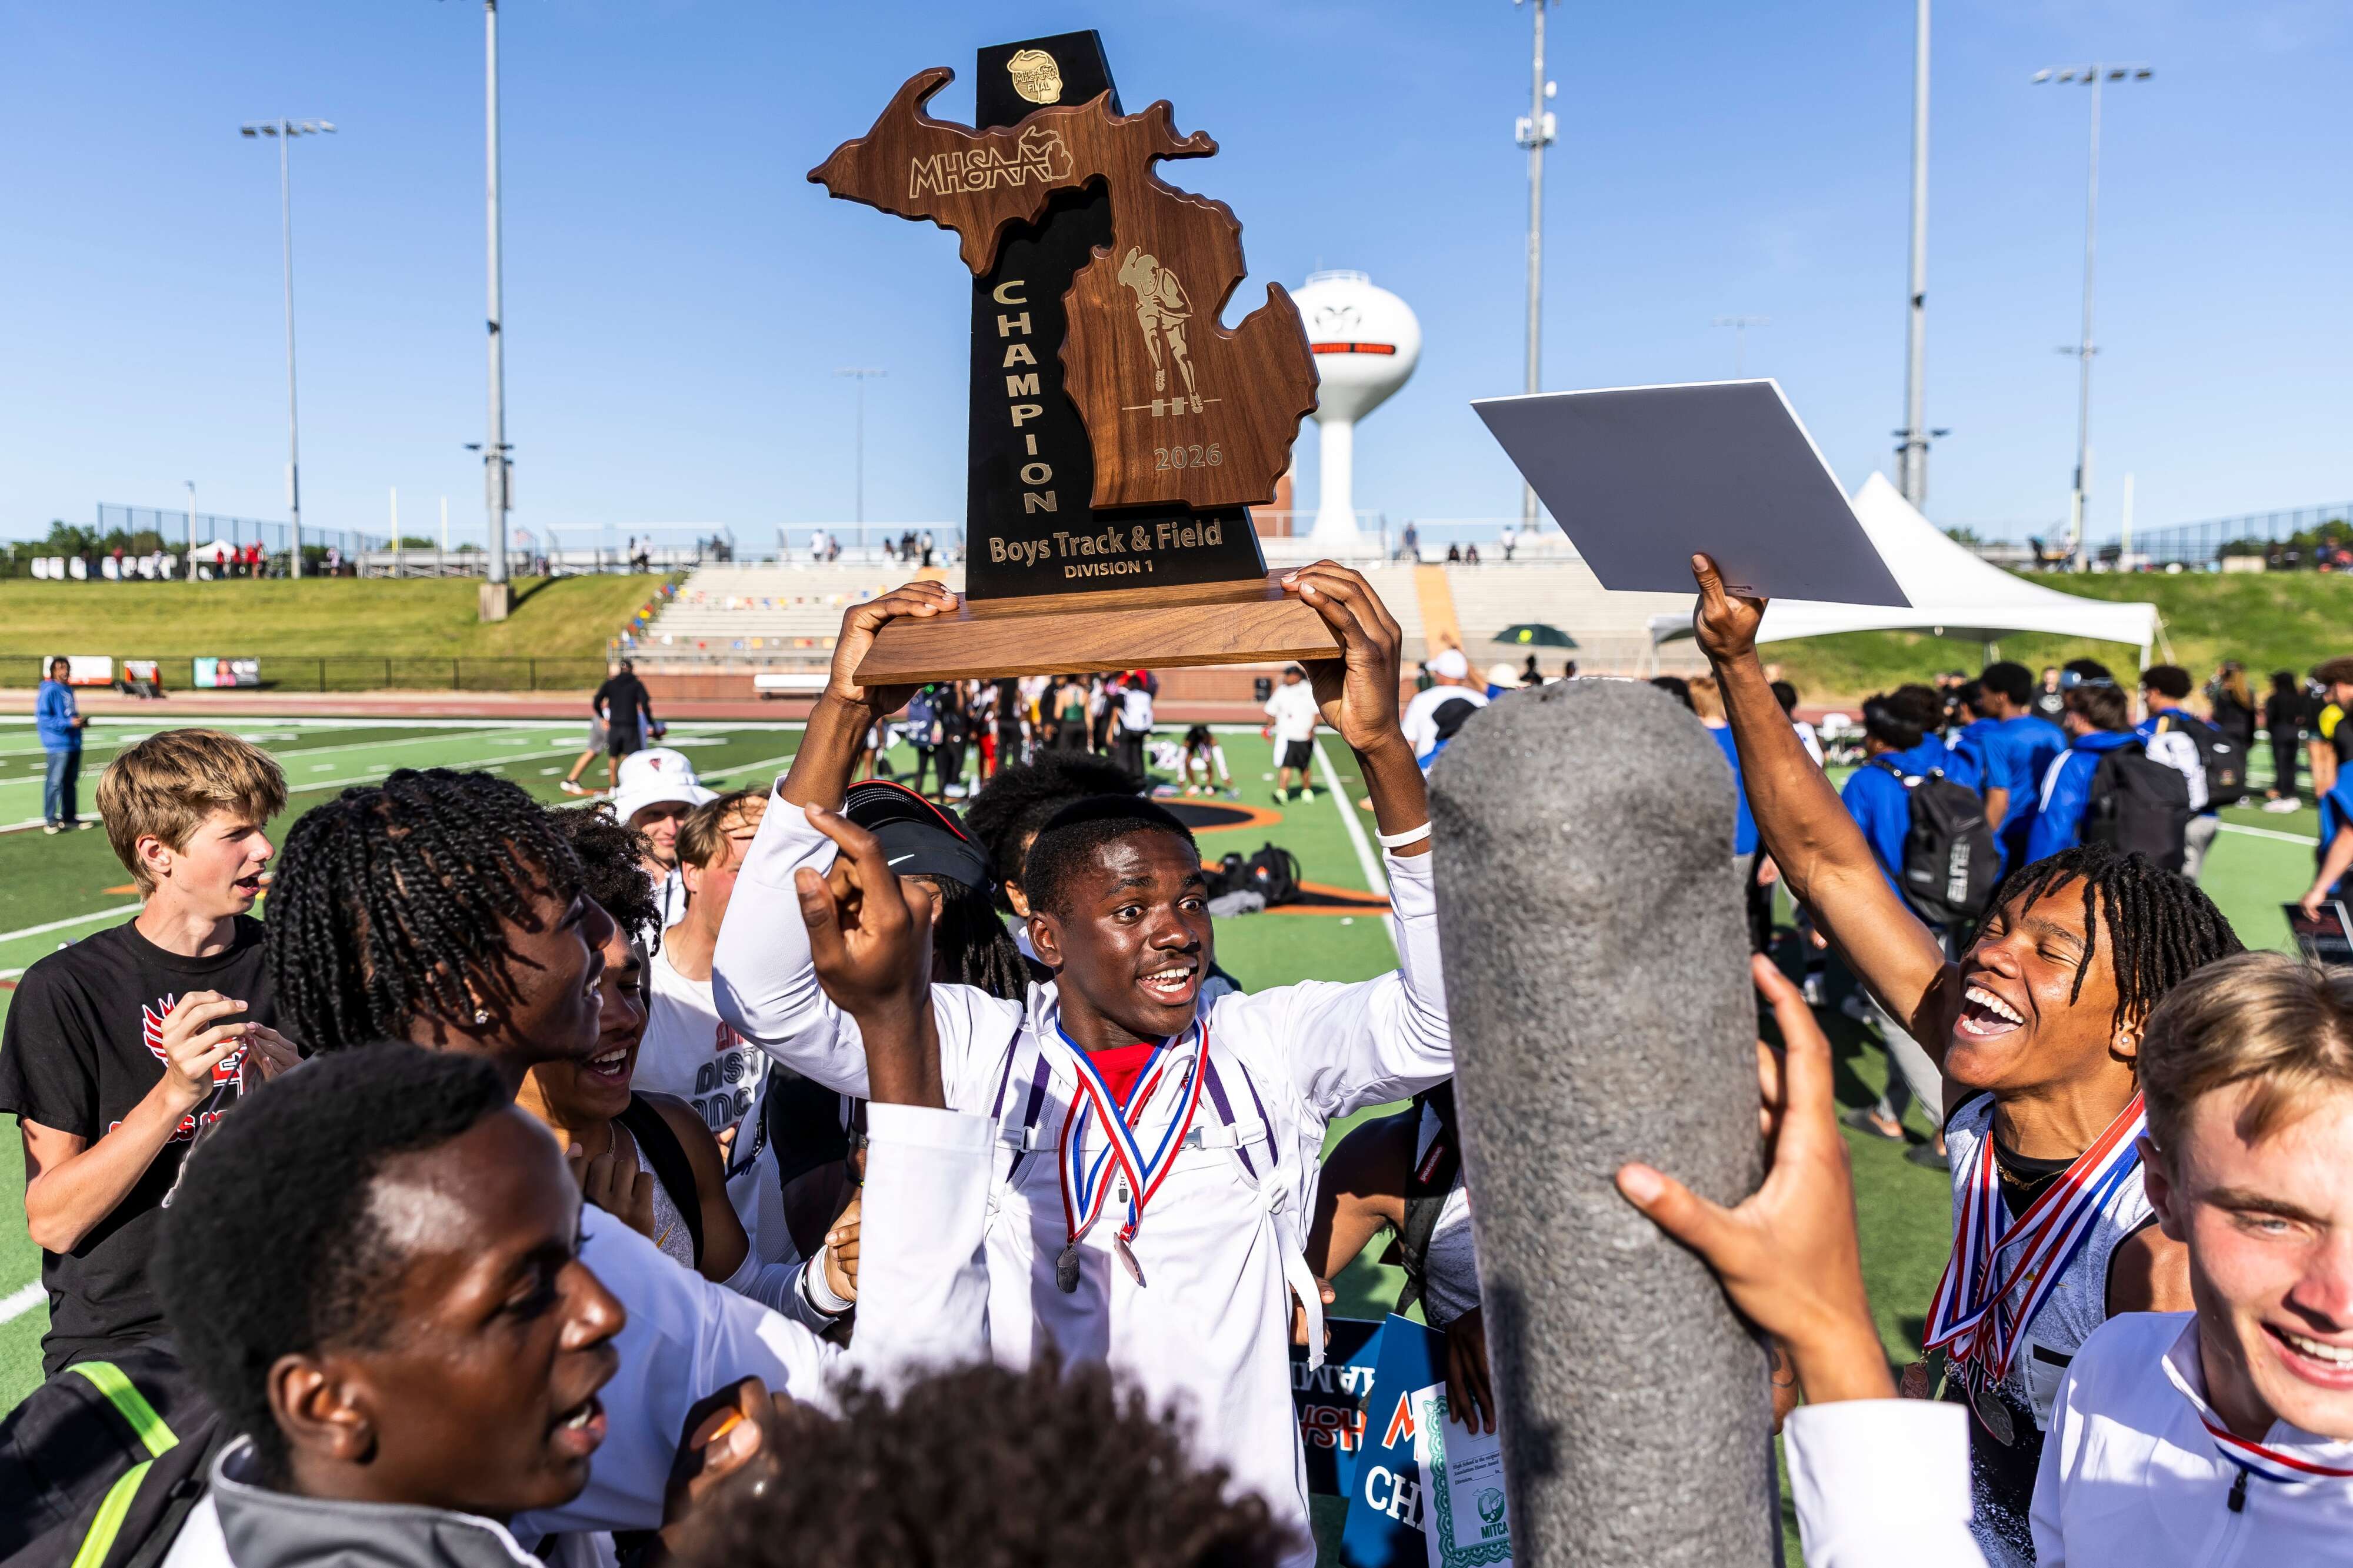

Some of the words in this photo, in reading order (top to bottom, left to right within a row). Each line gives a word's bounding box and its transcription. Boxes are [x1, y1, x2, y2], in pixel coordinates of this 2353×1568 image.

[1027, 82, 1051, 92] FINAL
[909, 146, 1052, 199] MHSAA
[993, 280, 1057, 513] CHAMPION
[1154, 443, 1223, 471] 2026
[989, 537, 1051, 567] Boys
[1053, 527, 1126, 558] Track
[1131, 525, 1152, 552] &
[1156, 518, 1222, 549] Field
[1065, 561, 1140, 578] DIVISION
[1145, 560, 1153, 572] 1
[1365, 1466, 1425, 1532] CH
[1481, 1521, 1509, 1539] MITCA
